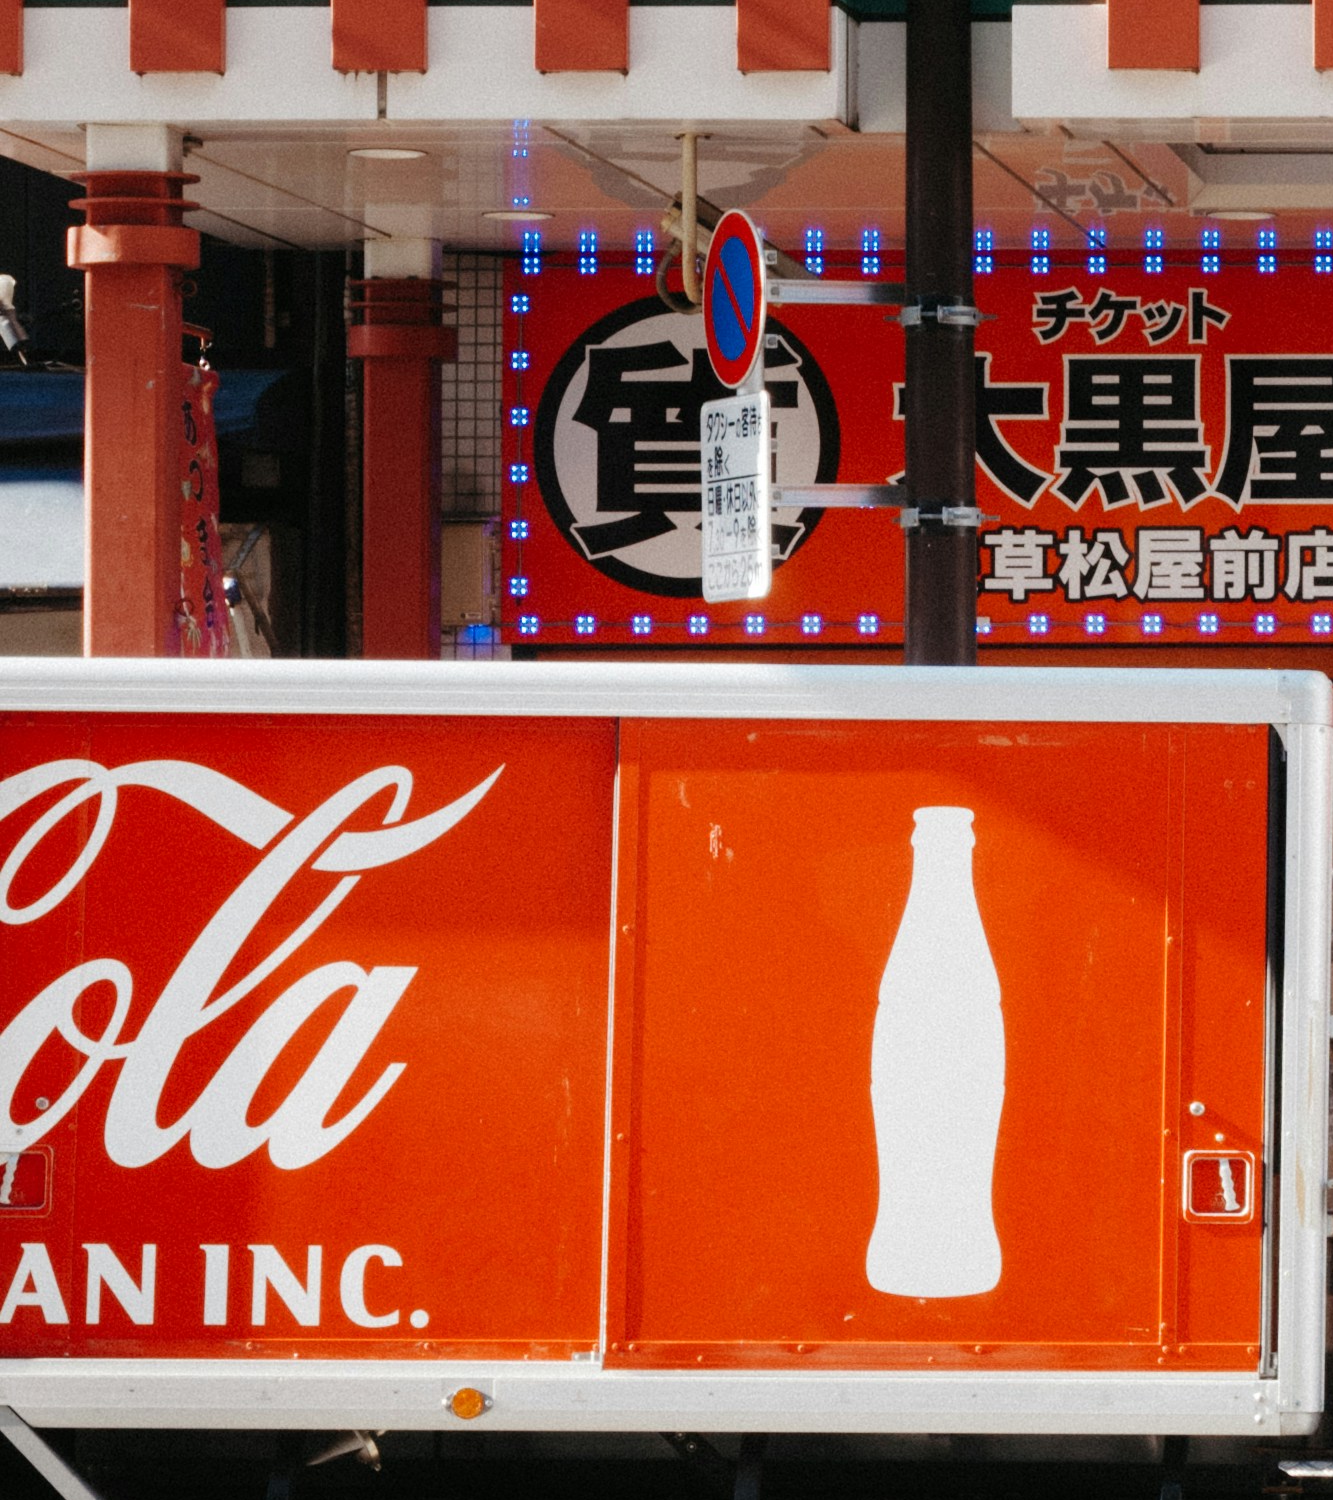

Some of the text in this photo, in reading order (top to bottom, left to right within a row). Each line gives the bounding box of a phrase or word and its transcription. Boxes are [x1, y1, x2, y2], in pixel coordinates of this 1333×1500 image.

[1031, 287, 1229, 346] チケット
[200, 1243, 429, 1328] INC.
